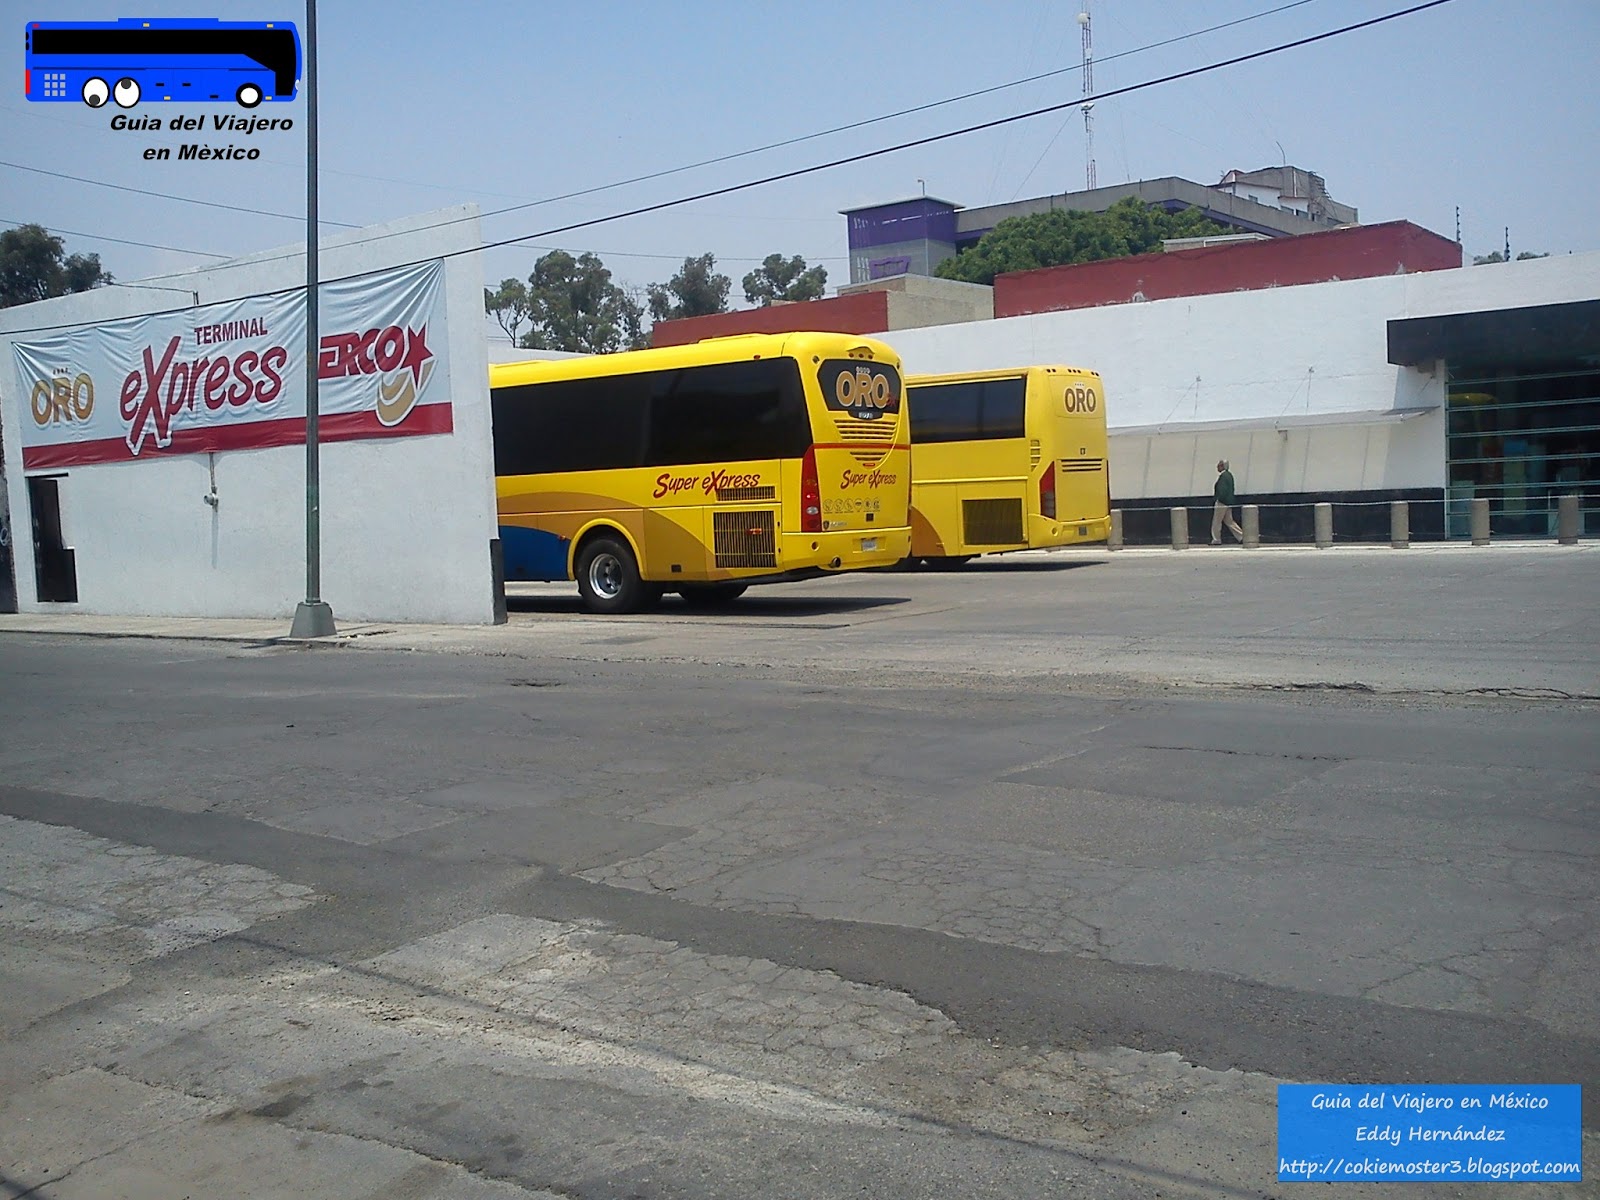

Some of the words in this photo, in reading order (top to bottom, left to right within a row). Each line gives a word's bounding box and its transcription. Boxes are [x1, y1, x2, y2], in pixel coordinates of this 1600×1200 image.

[194, 317, 268, 345] TERMINAL
[31, 372, 94, 425] ORO
[120, 336, 287, 449] eXpress
[836, 370, 890, 409] ORO
[1064, 387, 1097, 413] ORO
[653, 473, 699, 499] Super
[701, 469, 761, 498] eXpress
[840, 469, 867, 489] Super
